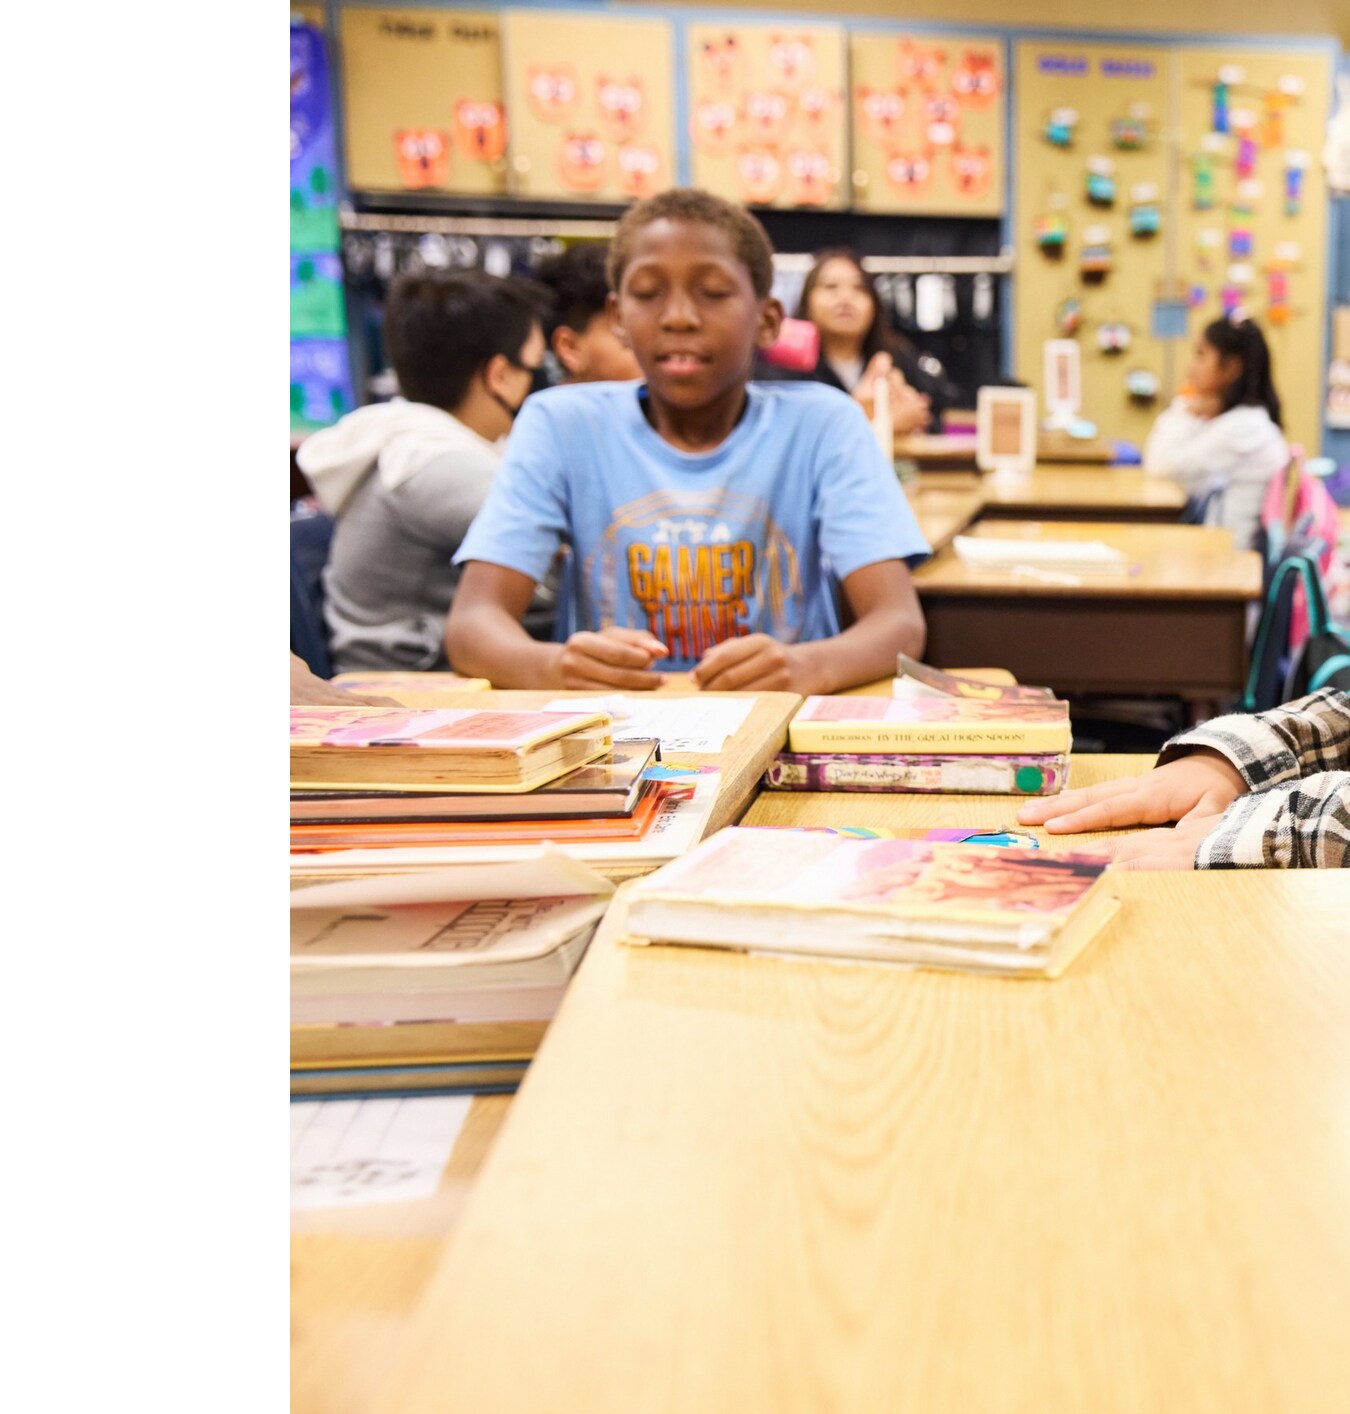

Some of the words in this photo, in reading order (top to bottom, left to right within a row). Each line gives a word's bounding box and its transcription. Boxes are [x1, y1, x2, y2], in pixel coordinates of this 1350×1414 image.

[711, 522, 730, 542] A
[627, 540, 754, 602] GAMER
[640, 600, 751, 661] THING
[878, 733, 889, 742] BY
[895, 733, 912, 742] THE
[917, 733, 950, 743] GREAT
[954, 733, 983, 743] HORN
[986, 733, 1025, 742] SPOON!
